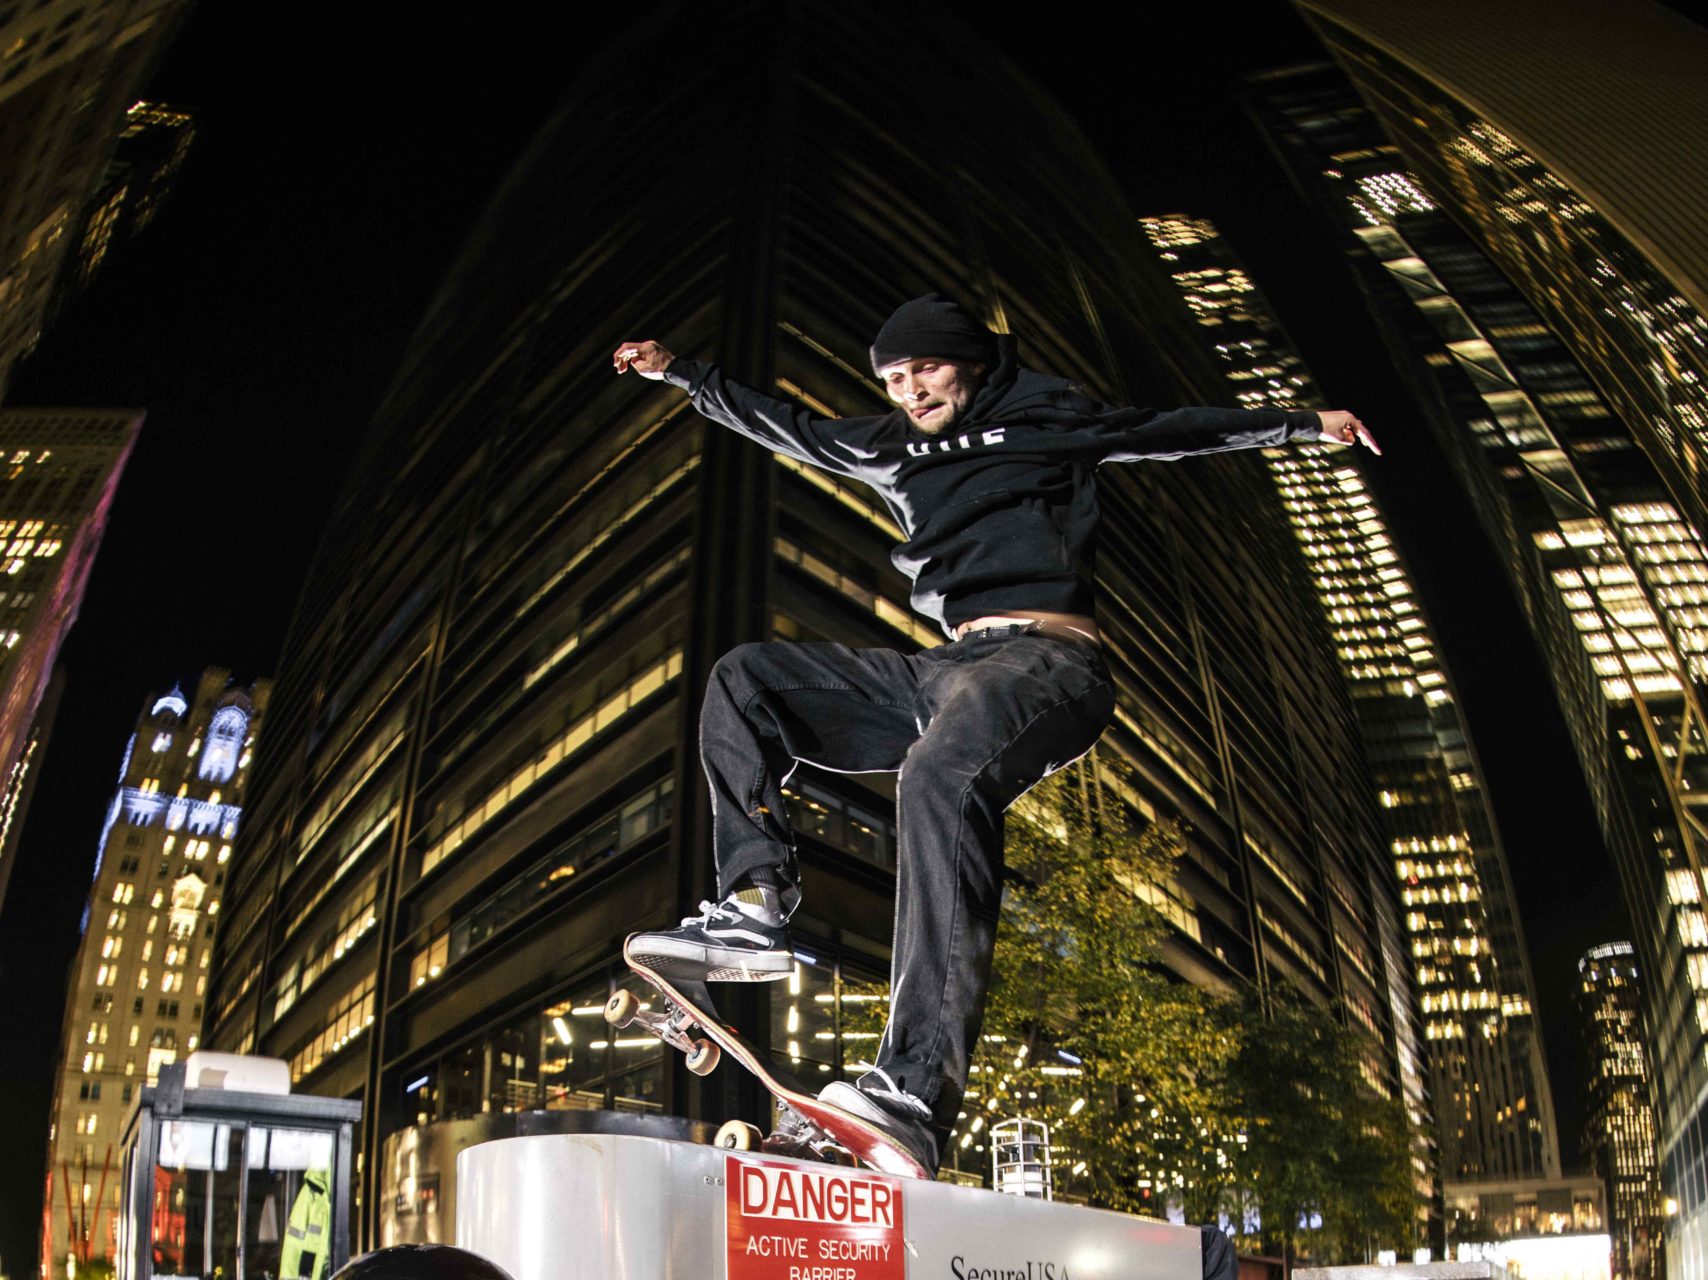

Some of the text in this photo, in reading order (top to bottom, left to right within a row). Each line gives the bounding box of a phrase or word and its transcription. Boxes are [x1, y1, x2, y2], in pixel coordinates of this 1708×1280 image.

[743, 1166, 891, 1226] DANGER
[746, 1235, 890, 1262] ACTIVE SECURITY
